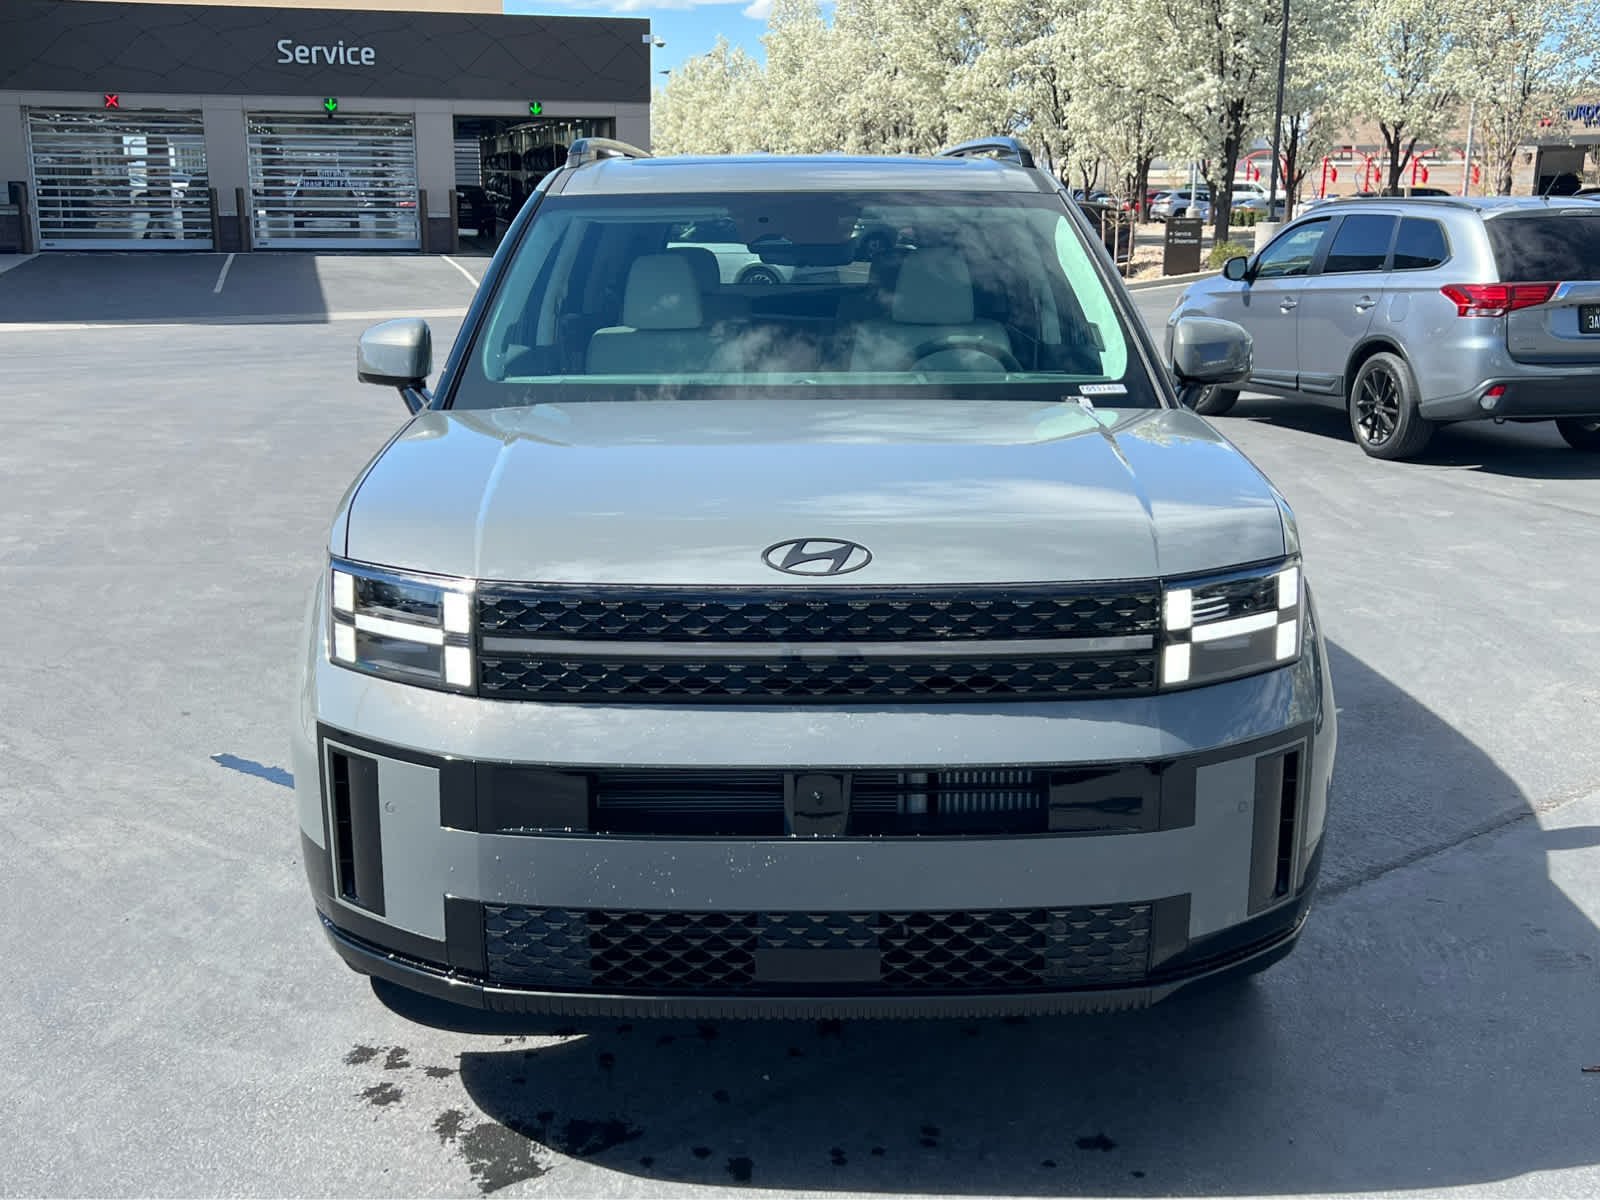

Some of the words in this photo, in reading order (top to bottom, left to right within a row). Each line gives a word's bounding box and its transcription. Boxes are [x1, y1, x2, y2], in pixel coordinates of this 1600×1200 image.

[276, 39, 376, 66] Service
[323, 179, 339, 188] Pull
[1588, 315, 1600, 329] 3A
